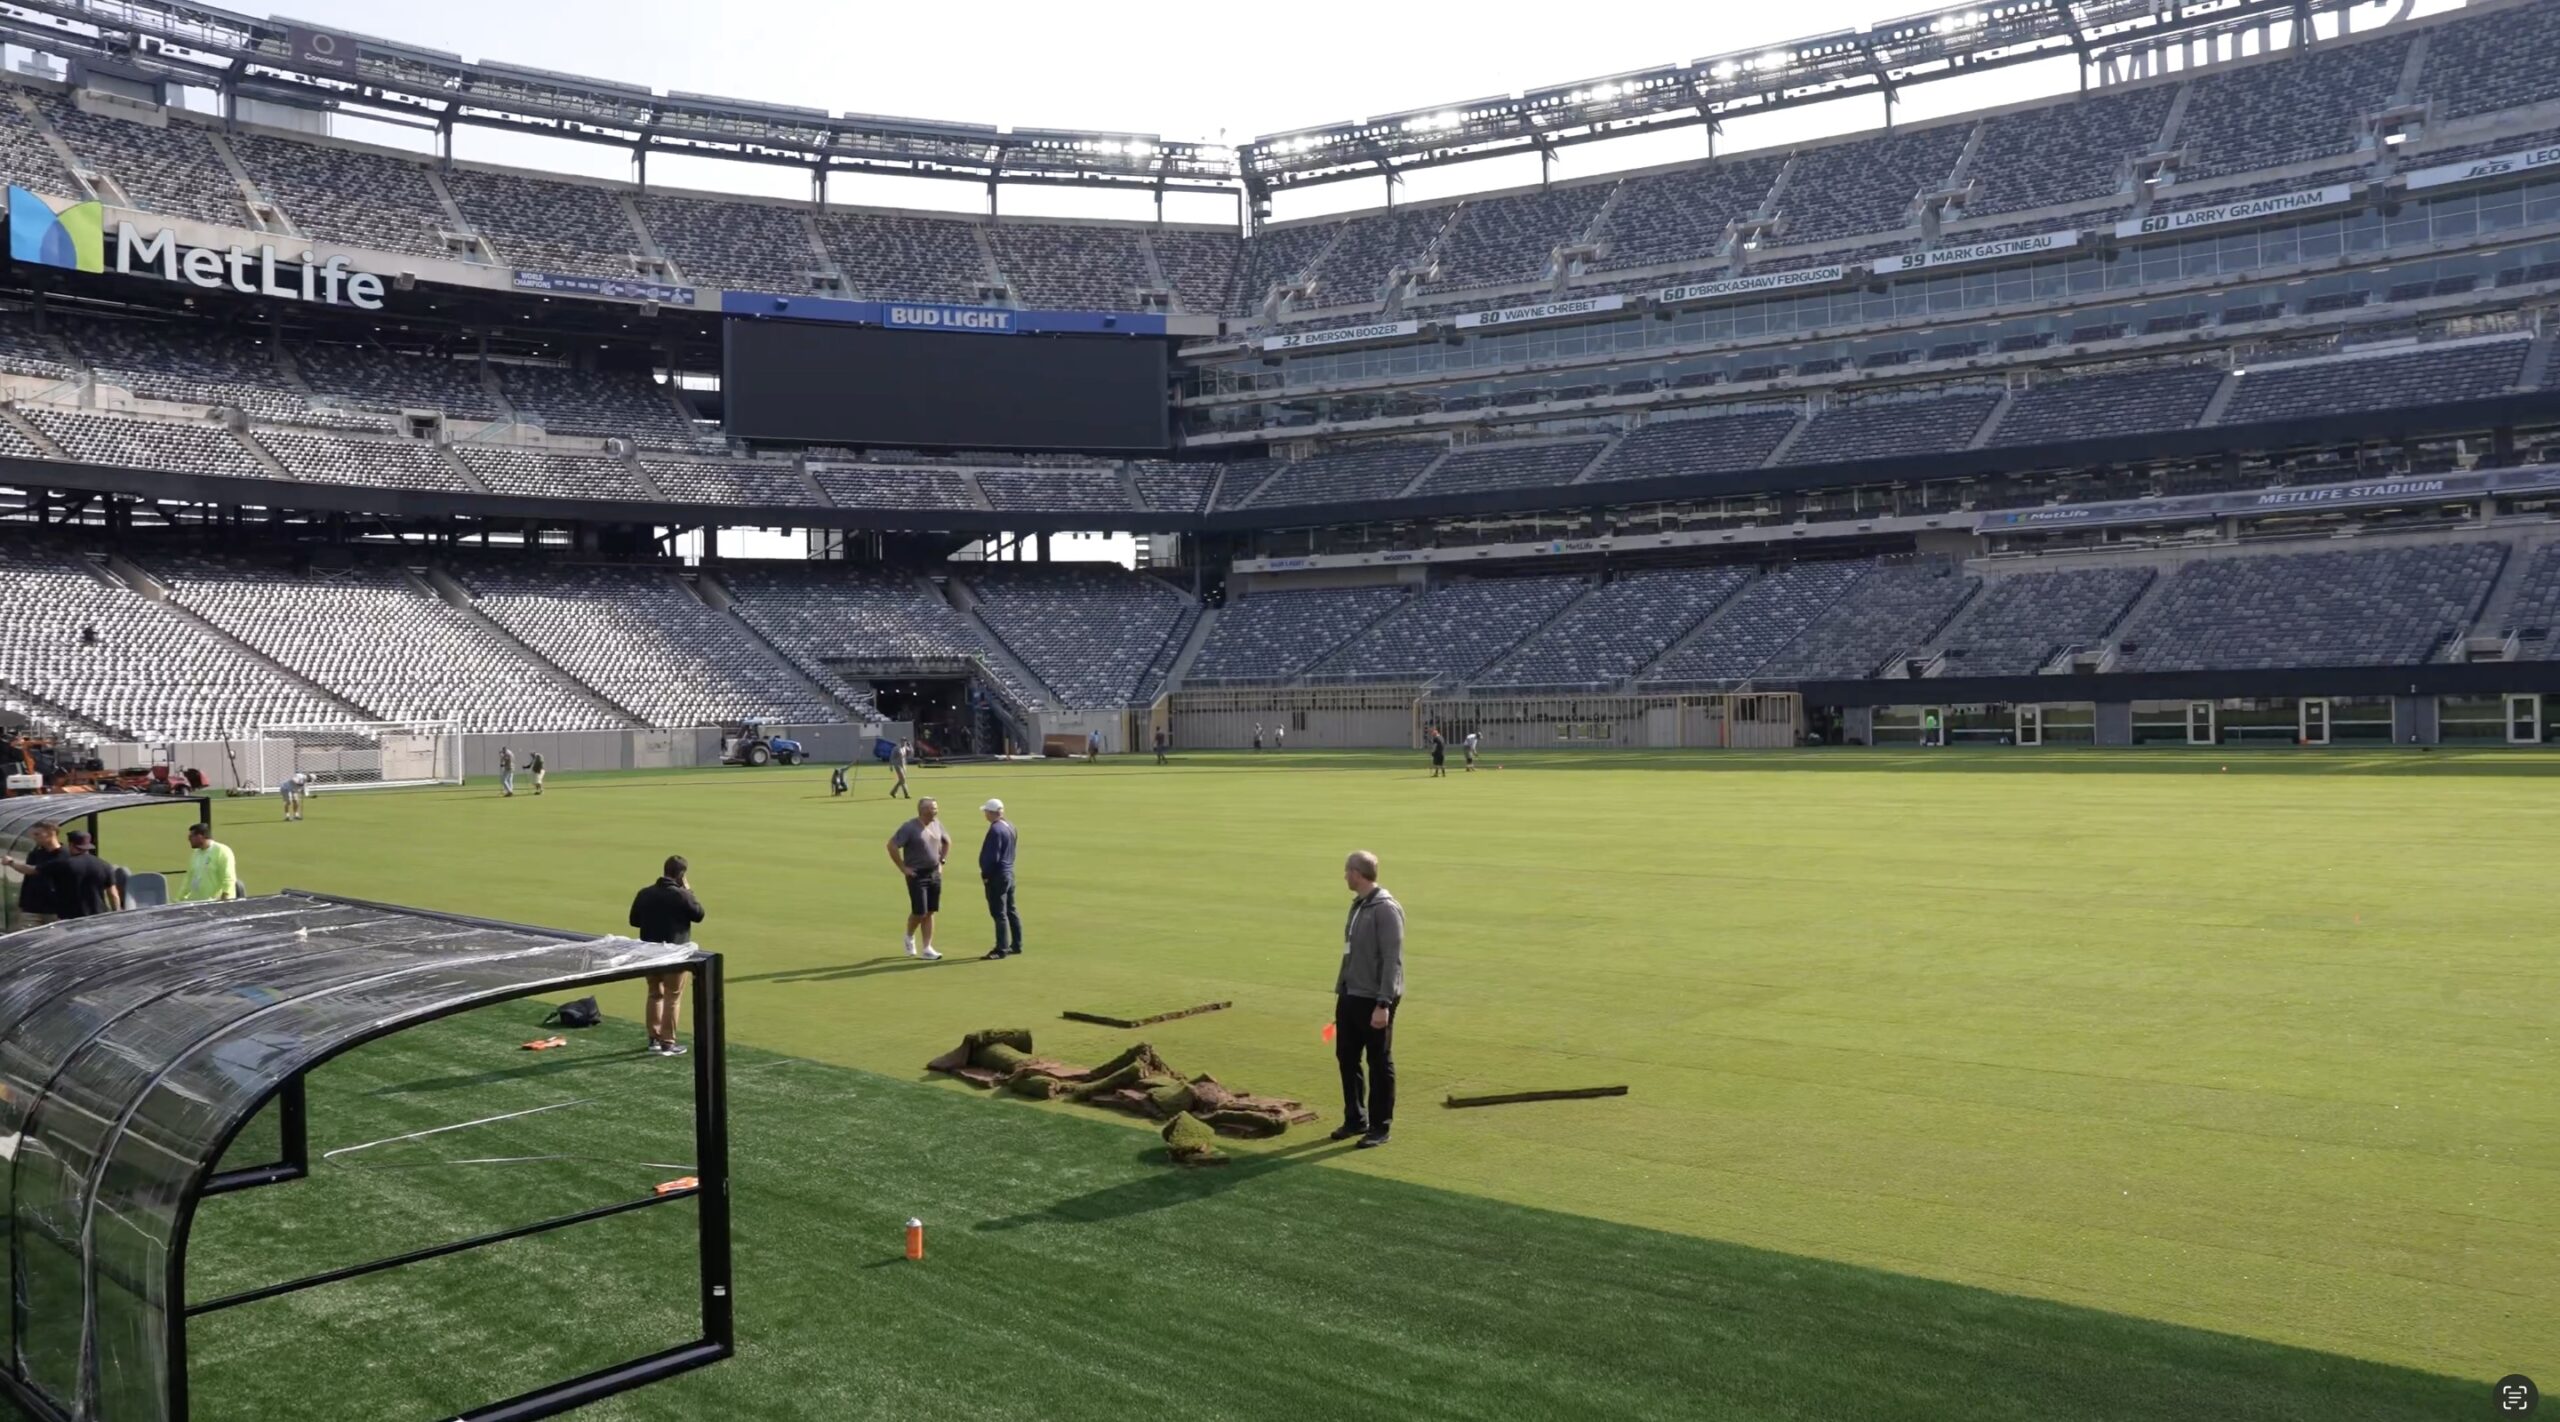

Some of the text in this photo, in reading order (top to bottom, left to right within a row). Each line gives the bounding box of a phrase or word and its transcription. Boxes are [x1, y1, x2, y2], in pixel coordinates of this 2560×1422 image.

[2462, 160, 2514, 178] JETS
[2141, 191, 2323, 233] 60 LARRY GRANTHAM
[1901, 236, 2053, 269] 99 MARK GASTINEAU
[116, 221, 385, 309] MetLife
[520, 271, 544, 281] WORLD
[513, 279, 551, 289] CHAMPIONS
[1663, 268, 1840, 301] 60 D'BRICKASHAW FERGUSON
[891, 307, 1010, 329] BUD LIGHT
[1479, 300, 1597, 324] 80 WAYNE CHREBET
[1282, 324, 1398, 347] 32 EMERSON BOOZER
[2258, 480, 2444, 505] METLIFE STADIUM
[2030, 510, 2090, 520] MetLife
